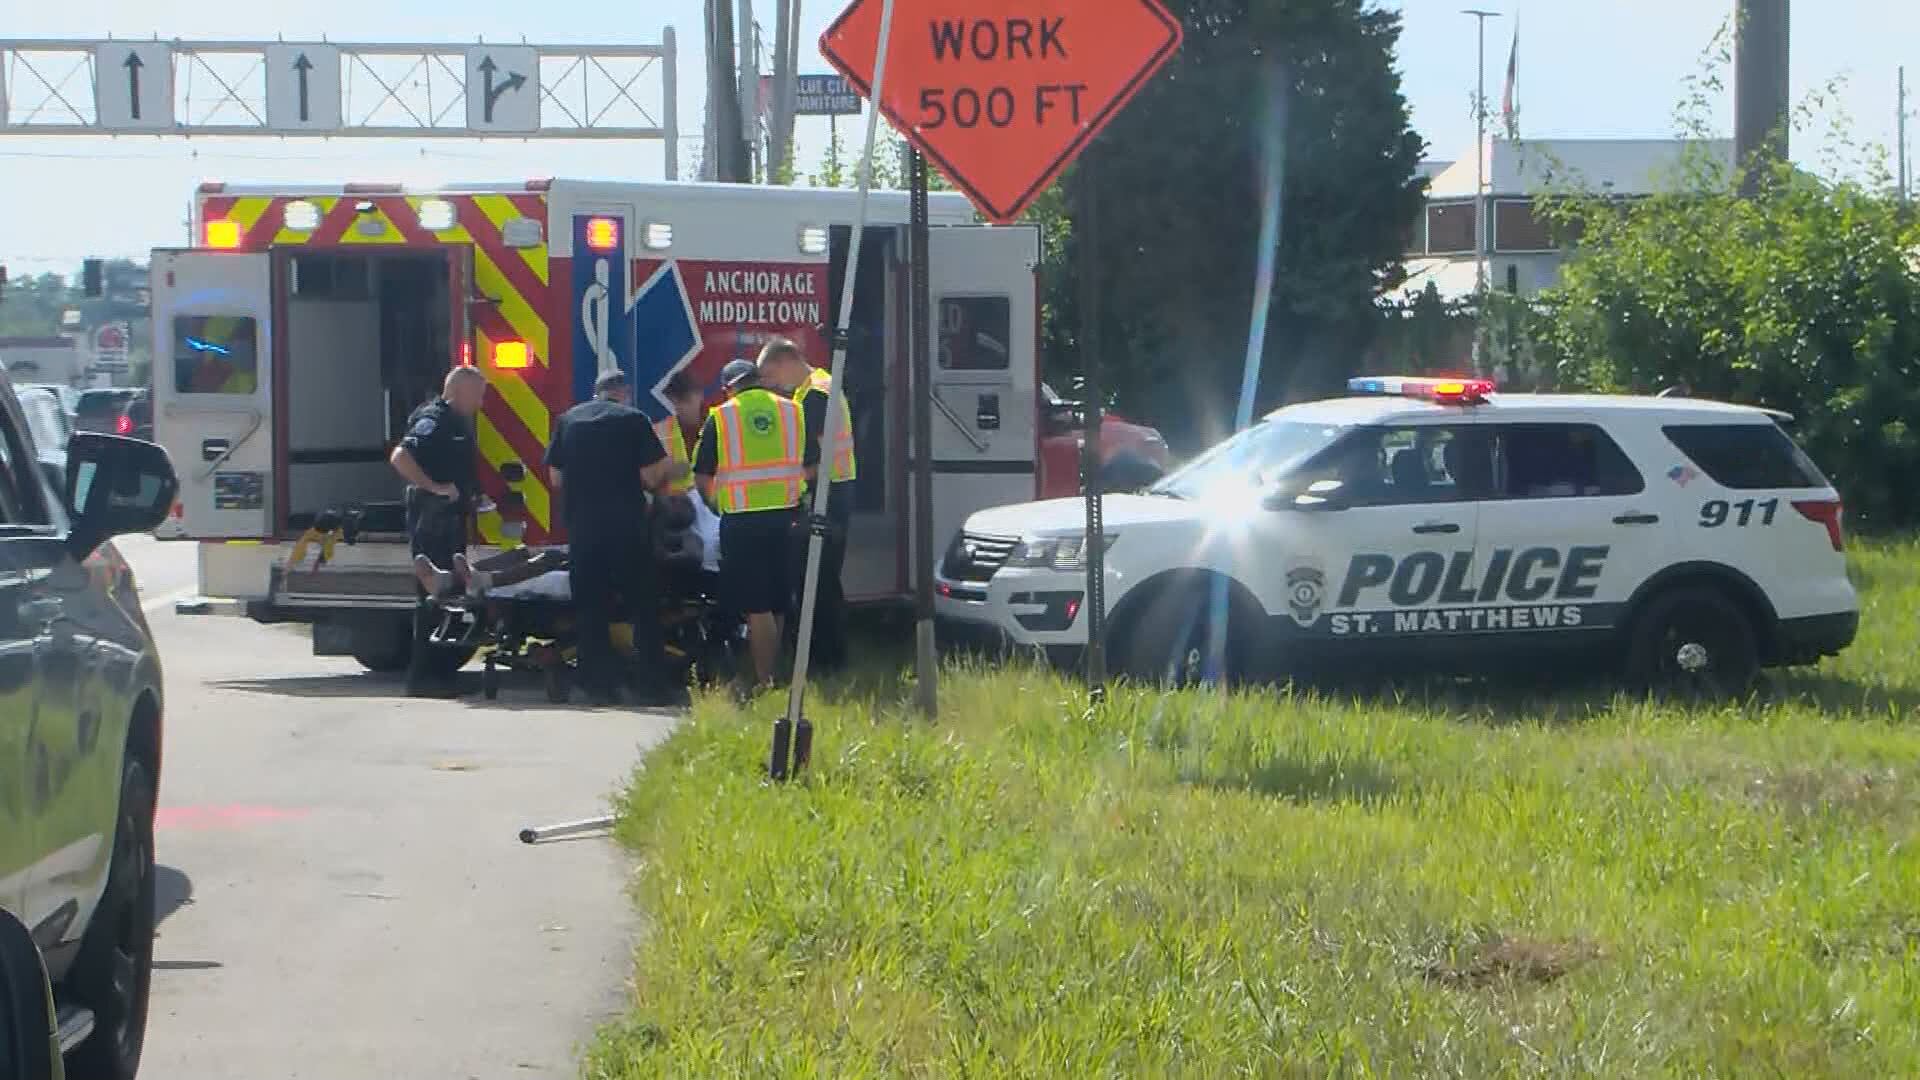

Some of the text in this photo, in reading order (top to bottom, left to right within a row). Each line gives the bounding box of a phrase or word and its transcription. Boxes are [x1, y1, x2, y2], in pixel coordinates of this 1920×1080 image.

[930, 16, 1067, 60] WORK
[798, 79, 824, 94] LUE
[798, 95, 858, 111] RNITURE
[919, 81, 1088, 128] 500 FT
[704, 271, 815, 294] ANCHORAGE
[700, 301, 820, 324] MIDDLETOWN
[1698, 498, 1779, 527] 911
[1336, 545, 1610, 607] POLICE
[1331, 605, 1582, 634] ST. MATTHEWS
